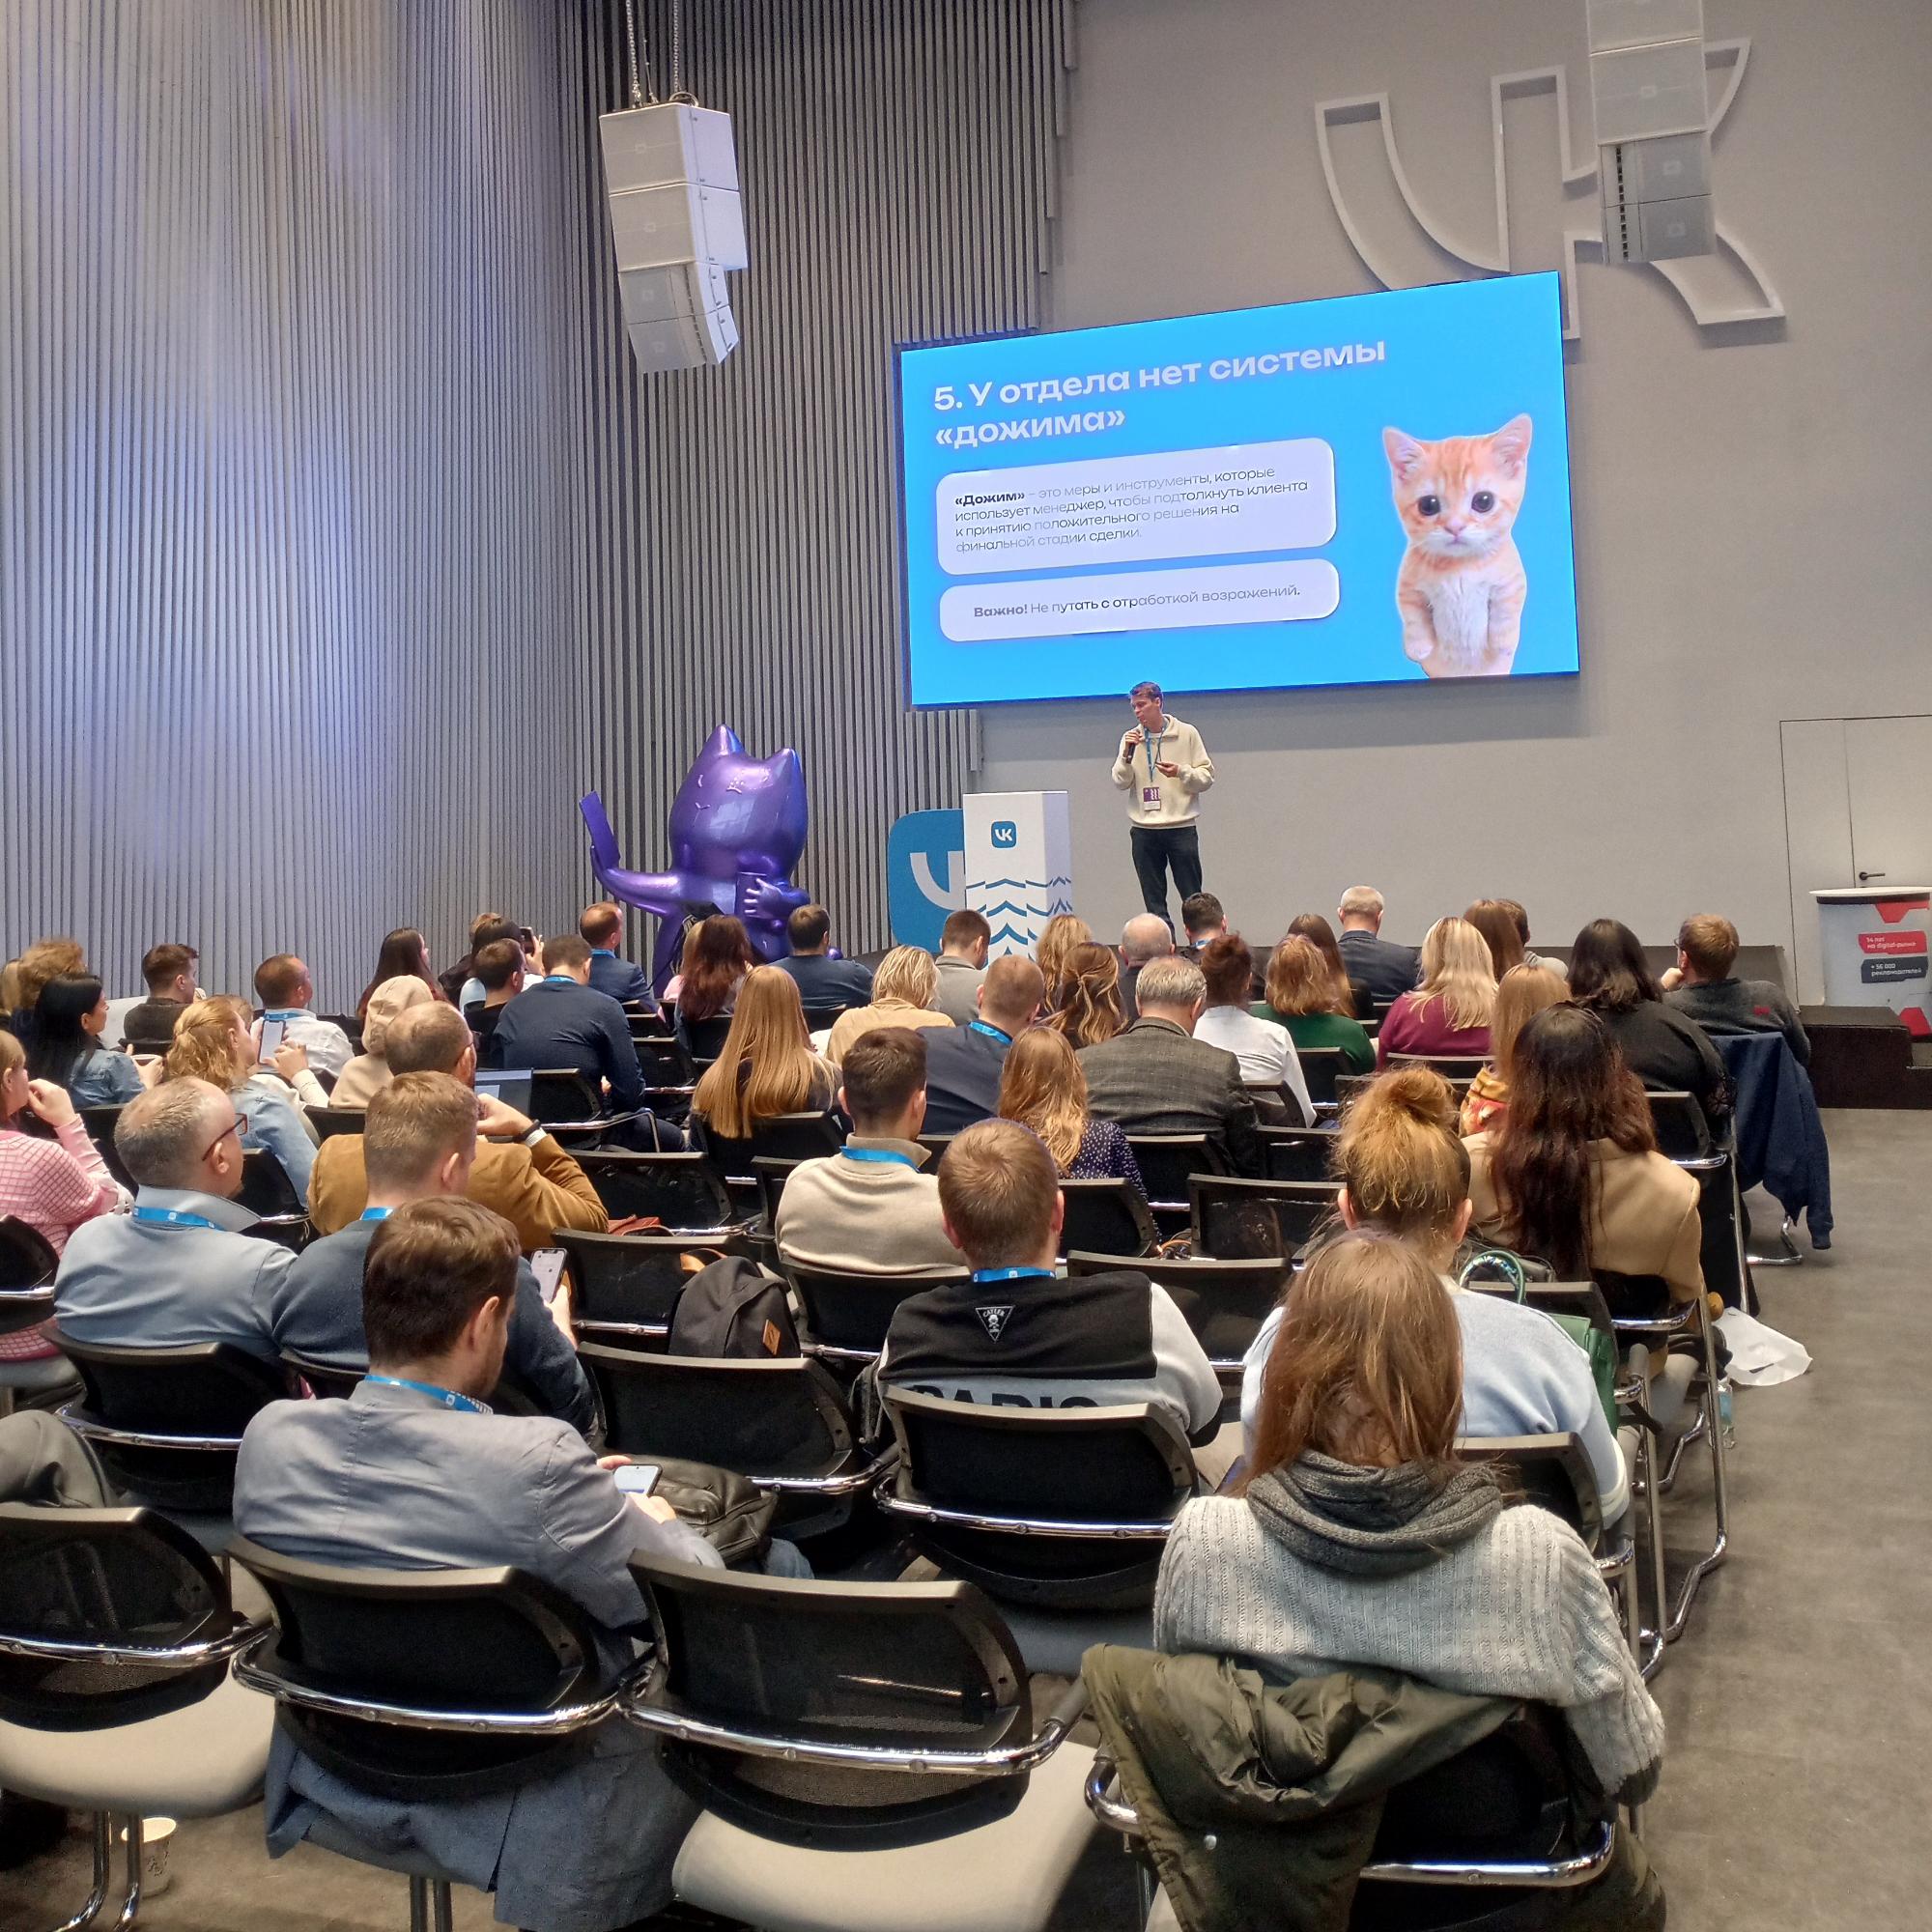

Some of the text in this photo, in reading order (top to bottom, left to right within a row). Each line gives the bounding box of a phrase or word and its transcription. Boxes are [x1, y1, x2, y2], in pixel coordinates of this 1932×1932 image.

[934, 340, 1385, 411] 5. У отдела нет системы
[935, 410, 1126, 449] «дожима»
[954, 491, 1025, 507] «Дожим»
[1038, 487, 1062, 498] это
[1064, 484, 1101, 497] меры
[1103, 483, 1113, 493] и
[1116, 473, 1212, 491] инструменты,
[1214, 468, 1276, 483] которые
[954, 481, 1308, 522] использует менеджер, чтобы подтолкнуть клиента
[955, 503, 1239, 538] к принятию положительного решения на
[955, 536, 1036, 554] финальной
[1037, 533, 1087, 546] стадии
[974, 583, 1301, 617] Важно! Не путать с отработкой возражений.
[994, 828, 1013, 841] VK
